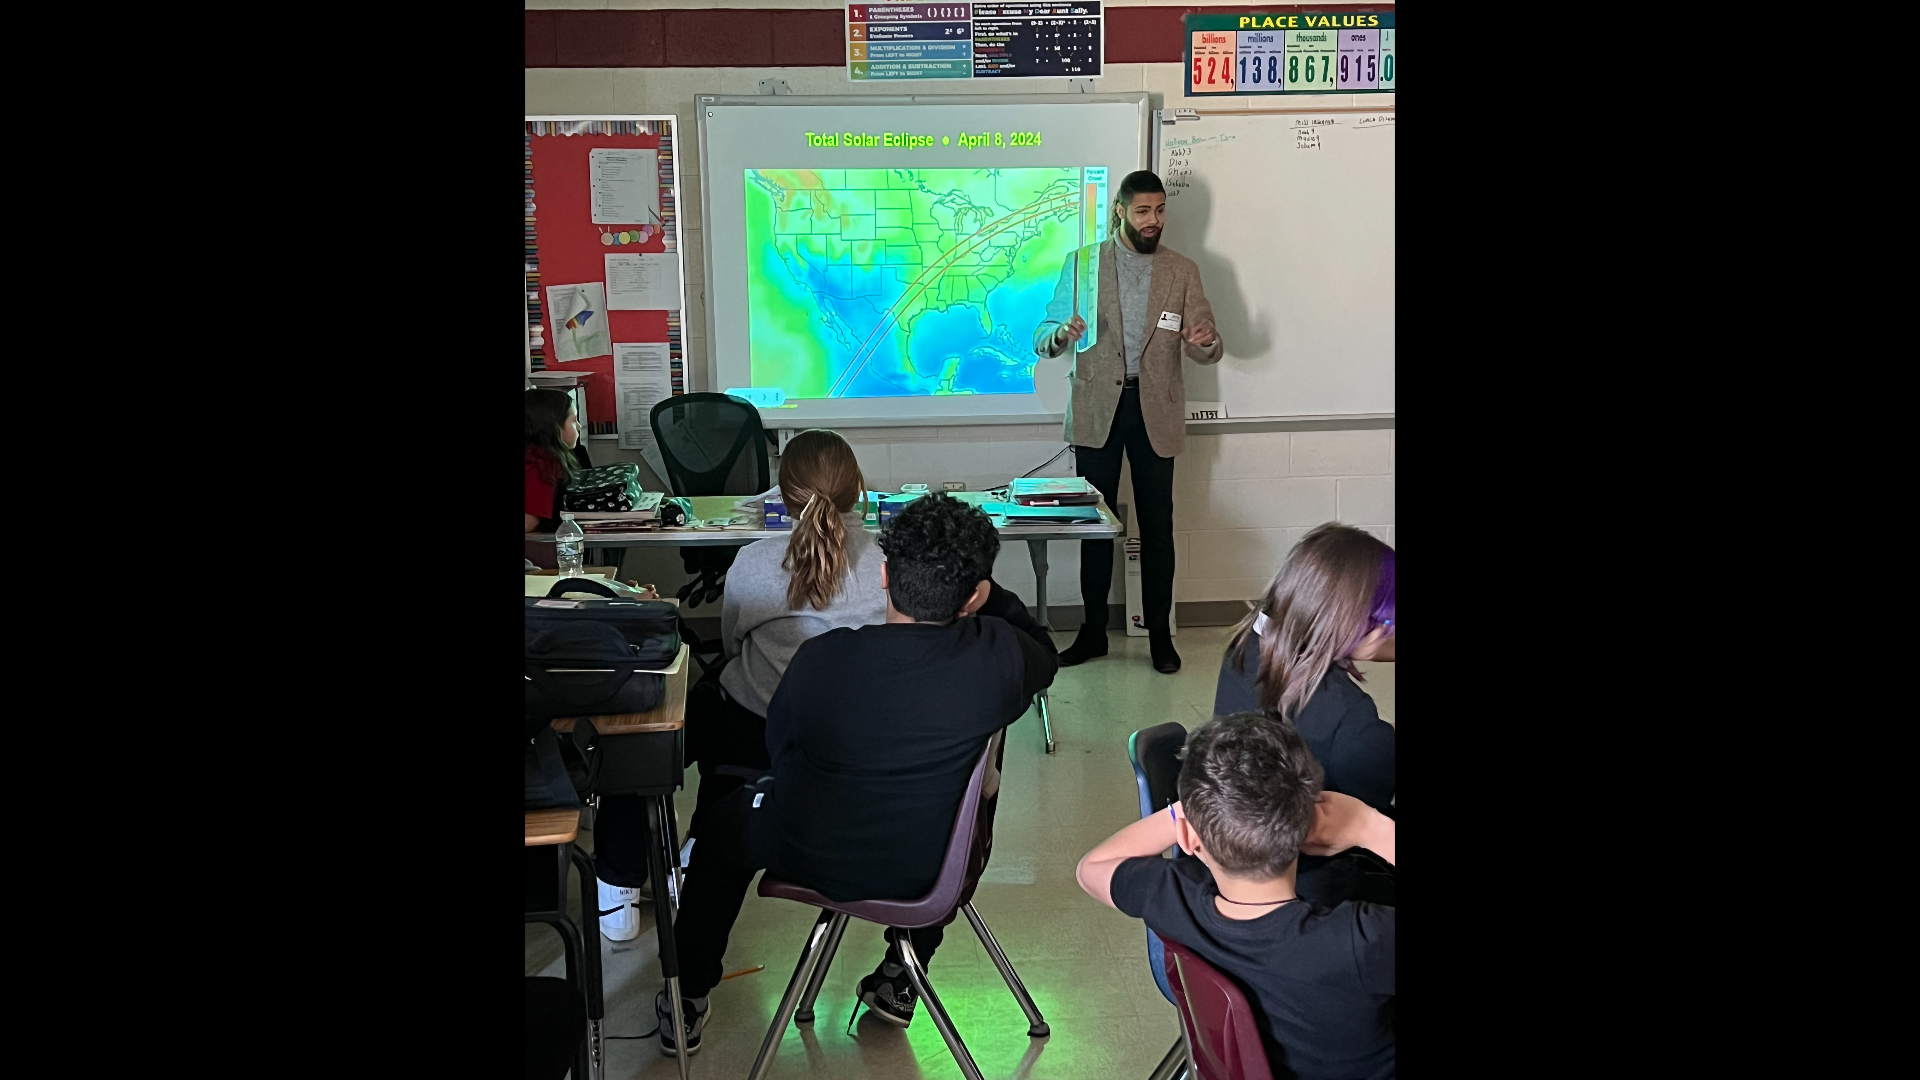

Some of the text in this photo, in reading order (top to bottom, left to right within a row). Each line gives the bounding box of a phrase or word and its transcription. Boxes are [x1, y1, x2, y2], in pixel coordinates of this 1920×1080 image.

[853, 9, 862, 18] 1.
[1239, 15, 1379, 28] PLACE VALUES
[853, 29, 862, 37] 2.
[1202, 33, 1226, 43] billions
[1248, 33, 1273, 42] millions
[1296, 32, 1327, 42] thousands
[805, 132, 1042, 150] Total Solar Eclipse April 8, 2024
